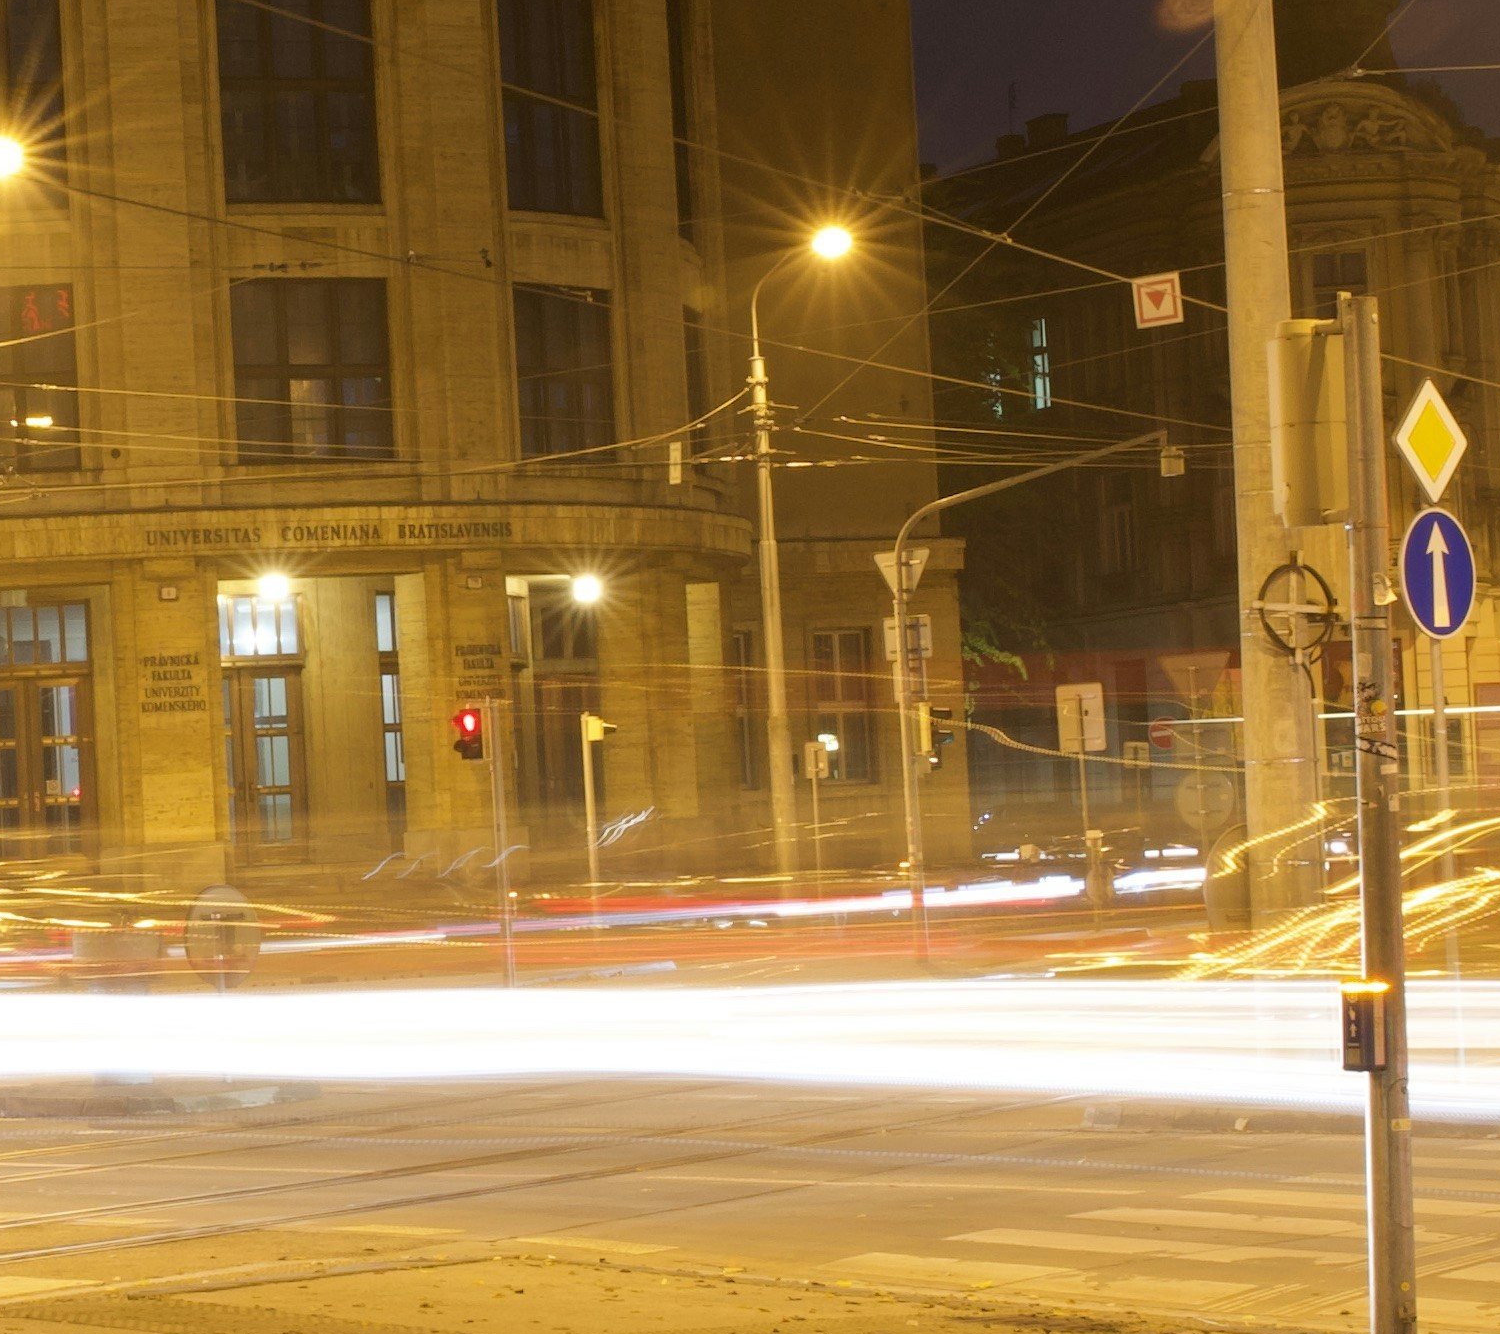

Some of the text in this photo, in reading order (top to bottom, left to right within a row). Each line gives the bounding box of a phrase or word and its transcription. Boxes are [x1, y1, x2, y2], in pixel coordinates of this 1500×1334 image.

[145, 521, 513, 547] UNIVERSITAS COMENIANA BRATISLAVENSIS
[151, 669, 192, 681] FAKULTA
[144, 686, 201, 698] UNIVERZITY
